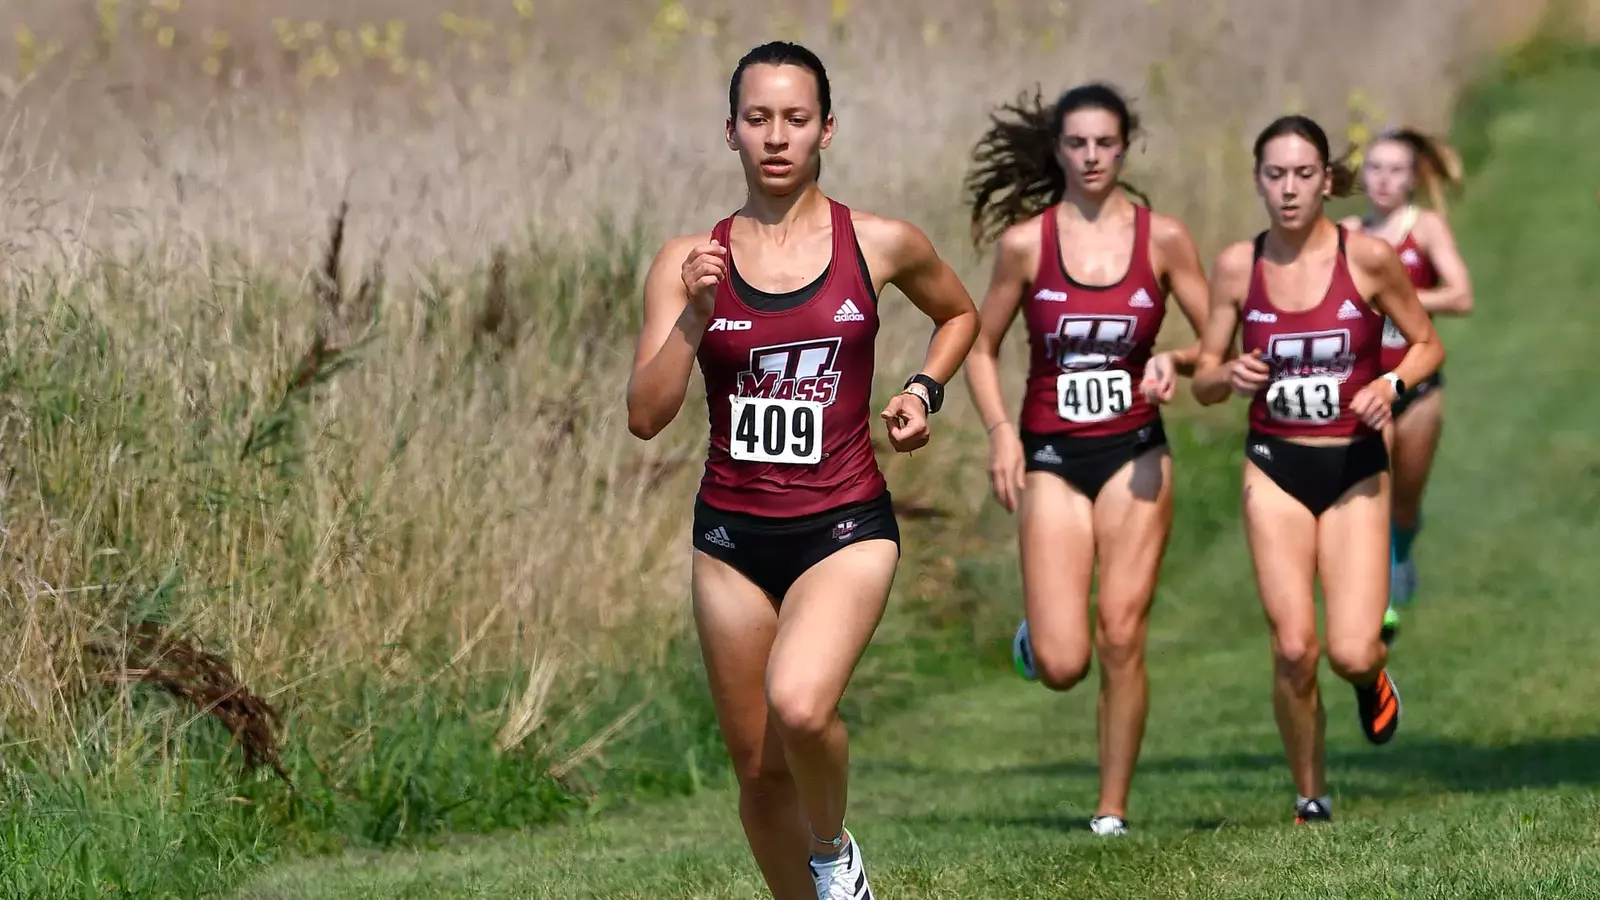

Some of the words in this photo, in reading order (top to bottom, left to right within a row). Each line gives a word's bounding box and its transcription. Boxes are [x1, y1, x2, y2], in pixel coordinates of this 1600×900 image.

[708, 318, 752, 331] A10
[834, 313, 865, 322] adidas
[1064, 377, 1125, 415] 405
[1272, 384, 1333, 419] 413
[735, 403, 815, 457] 409
[704, 532, 736, 549] adidas
